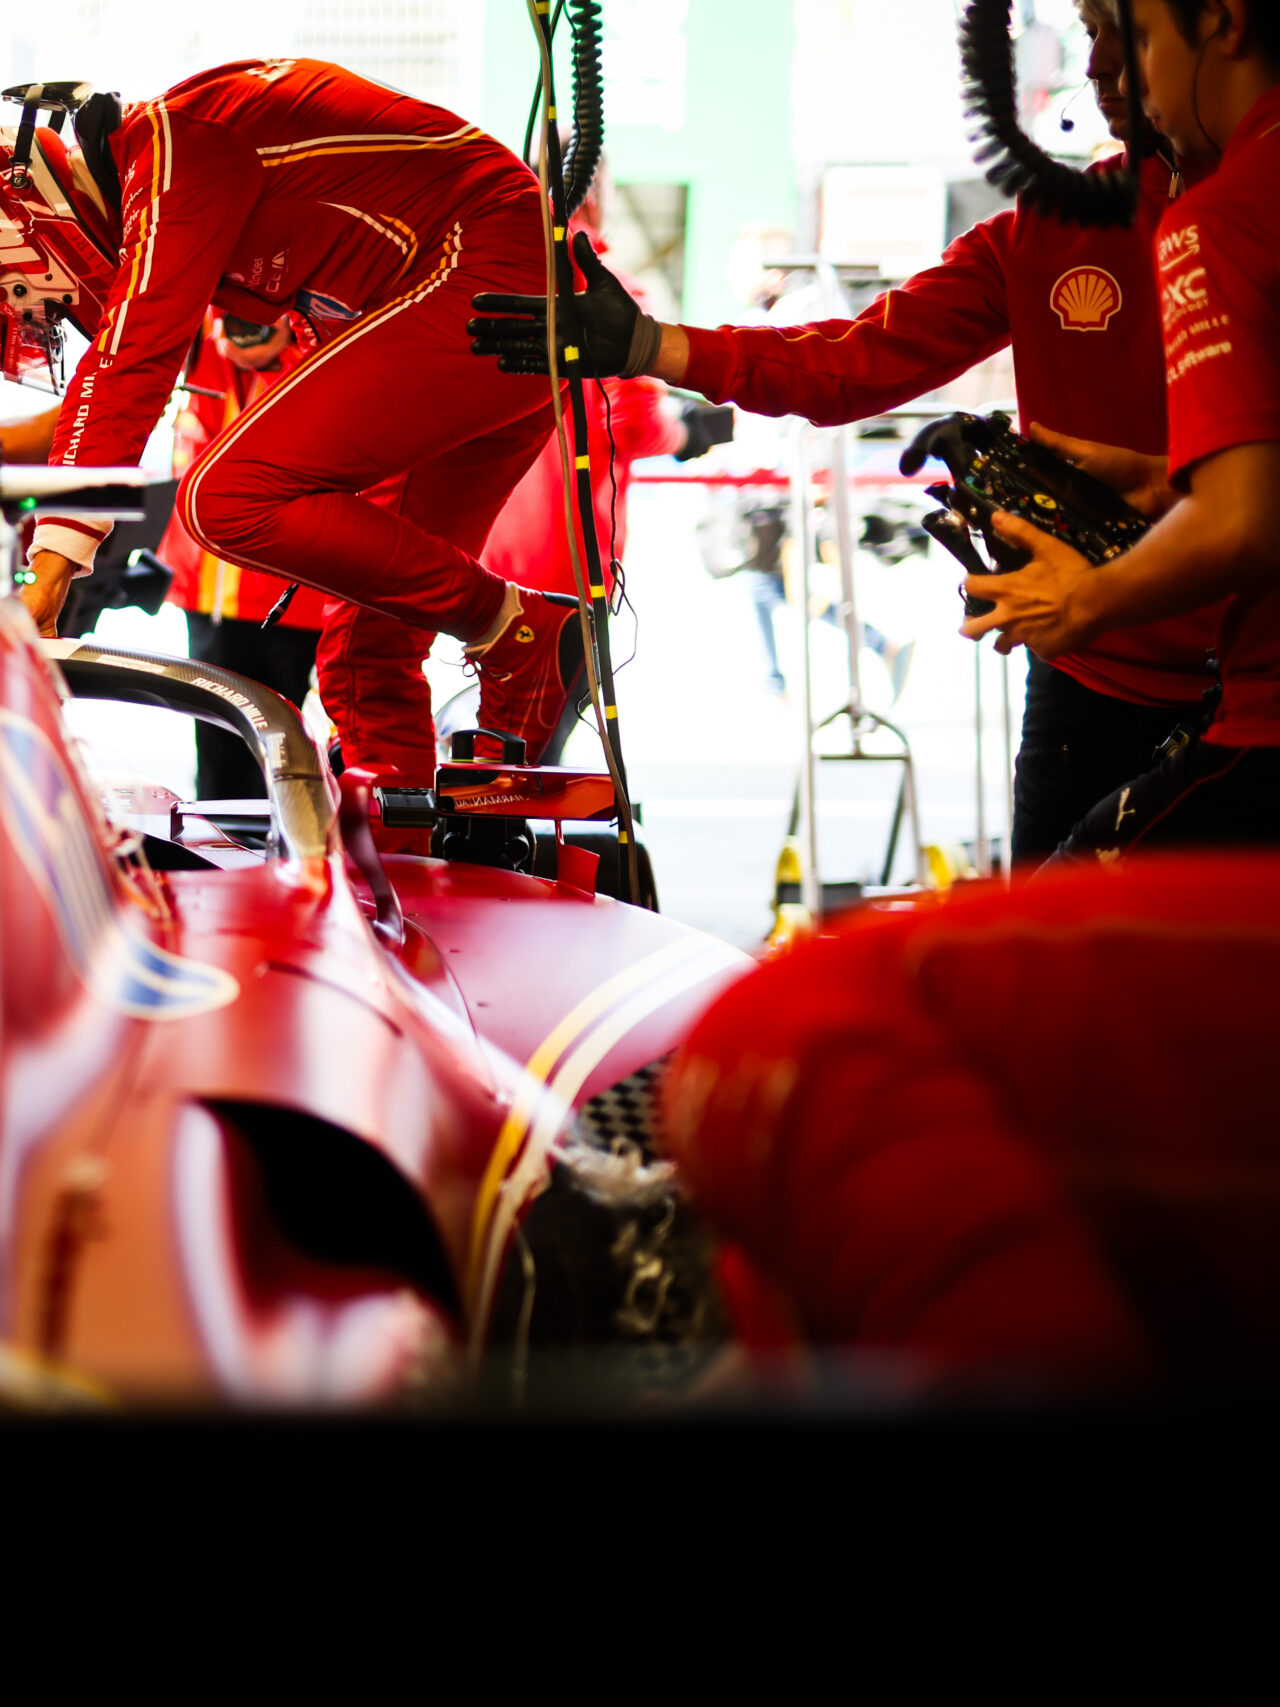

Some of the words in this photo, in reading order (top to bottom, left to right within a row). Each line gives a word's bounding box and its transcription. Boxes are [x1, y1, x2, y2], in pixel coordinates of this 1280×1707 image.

[62, 404, 90, 466] ICHARD
[80, 357, 114, 398] MIE
[190, 677, 250, 707] RICHARD
[242, 702, 269, 730] MILLE
